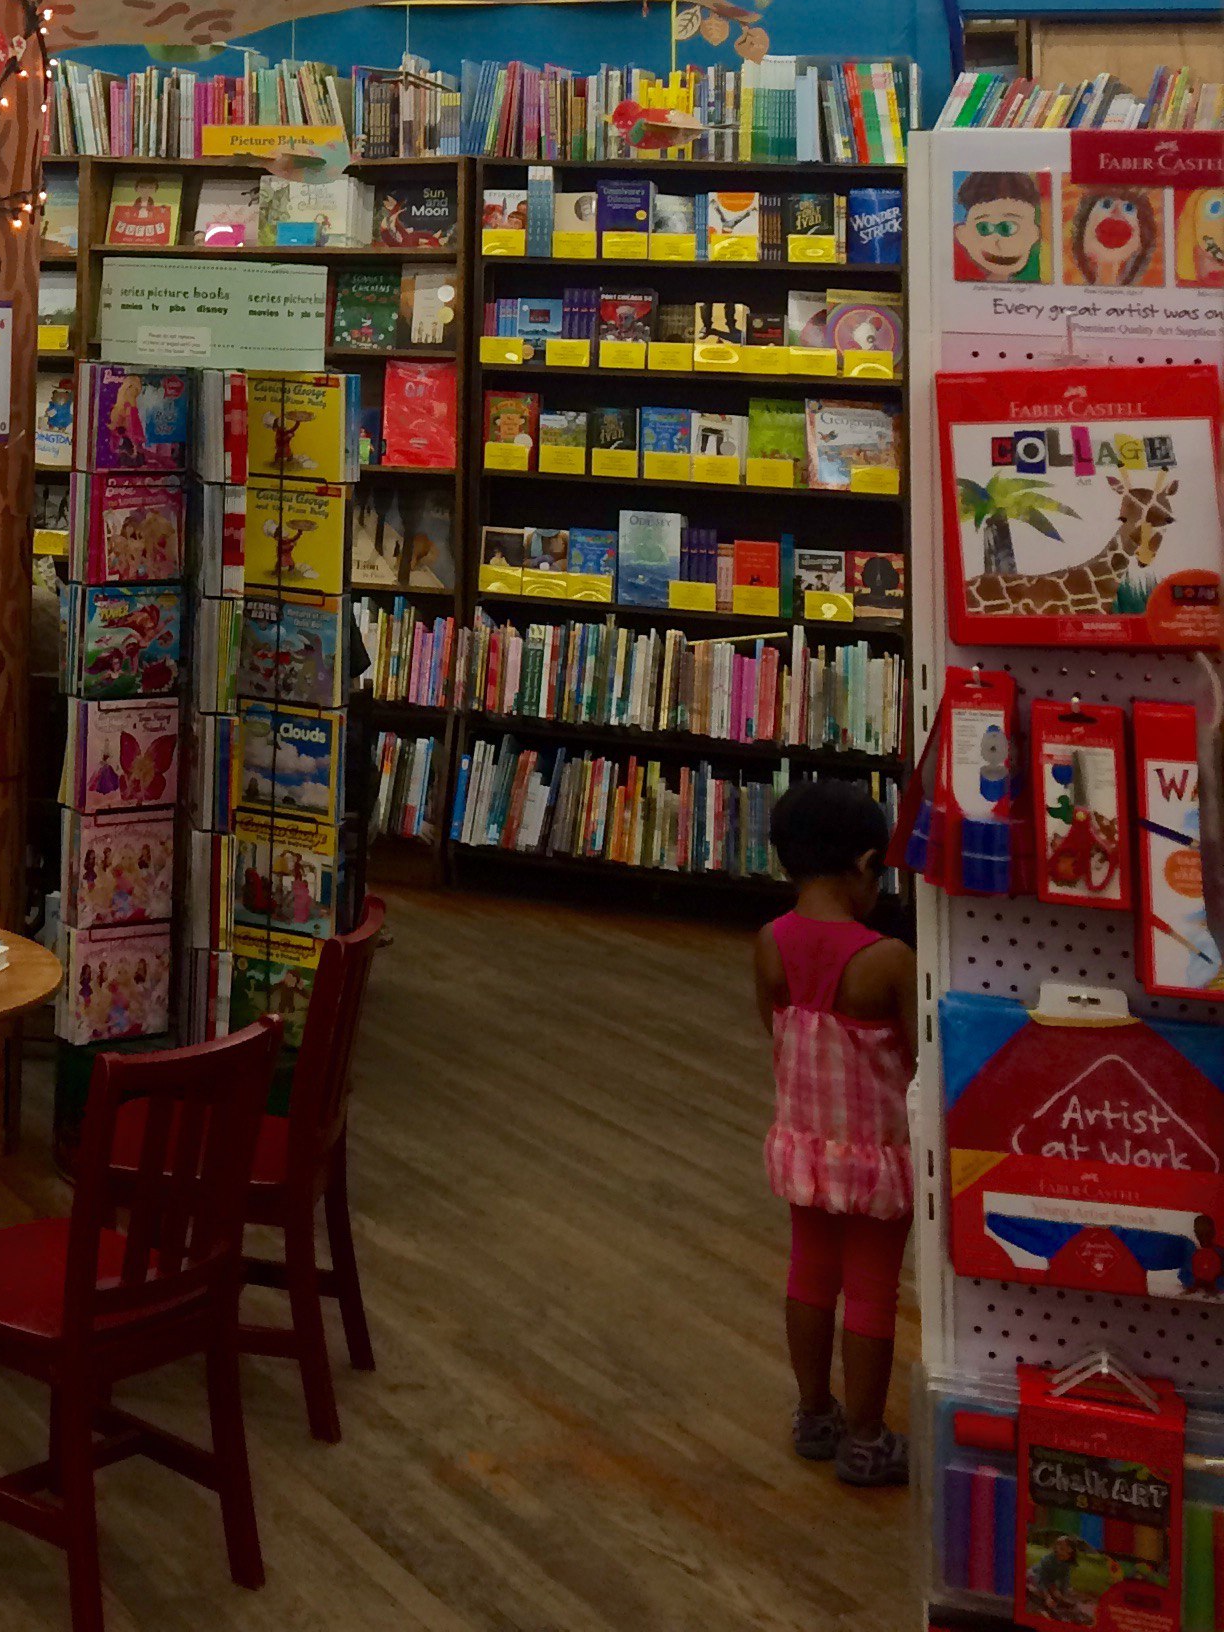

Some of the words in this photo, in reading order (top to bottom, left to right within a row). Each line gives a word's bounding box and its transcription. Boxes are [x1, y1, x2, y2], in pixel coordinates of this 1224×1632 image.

[229, 135, 275, 146] Picture
[422, 187, 445, 198] Sun
[425, 198, 448, 207] and
[411, 206, 449, 217] Moon
[851, 206, 901, 231] WONDER
[859, 218, 903, 245] STRUCK
[120, 285, 145, 297] series
[147, 287, 190, 300] picture
[193, 286, 231, 301] books
[247, 292, 282, 304] series
[283, 293, 313, 306] picture
[151, 303, 160, 311] tv
[196, 304, 229, 316] disney
[248, 309, 279, 317] movies
[992, 298, 1045, 320] Every
[1049, 301, 1101, 321] great
[1105, 302, 1160, 320] artist
[1163, 308, 1200, 320] was
[1204, 308, 1224, 320] on
[1118, 324, 1154, 336] Quality
[1175, 325, 1217, 337] Supplies
[253, 380, 291, 395] Curious
[293, 384, 327, 398] George
[1009, 401, 1064, 418] FABER
[1067, 398, 1147, 417] CASTELL
[993, 427, 1175, 469] COLLAGE
[1077, 478, 1092, 487] Art
[295, 492, 329, 507] George
[279, 722, 326, 744] Clouds
[1060, 1095, 1169, 1134] Artist
[1041, 1133, 1089, 1161] at
[1099, 1138, 1192, 1171] Work
[1032, 1461, 1110, 1499] Chalk
[1111, 1477, 1169, 1509] ART
